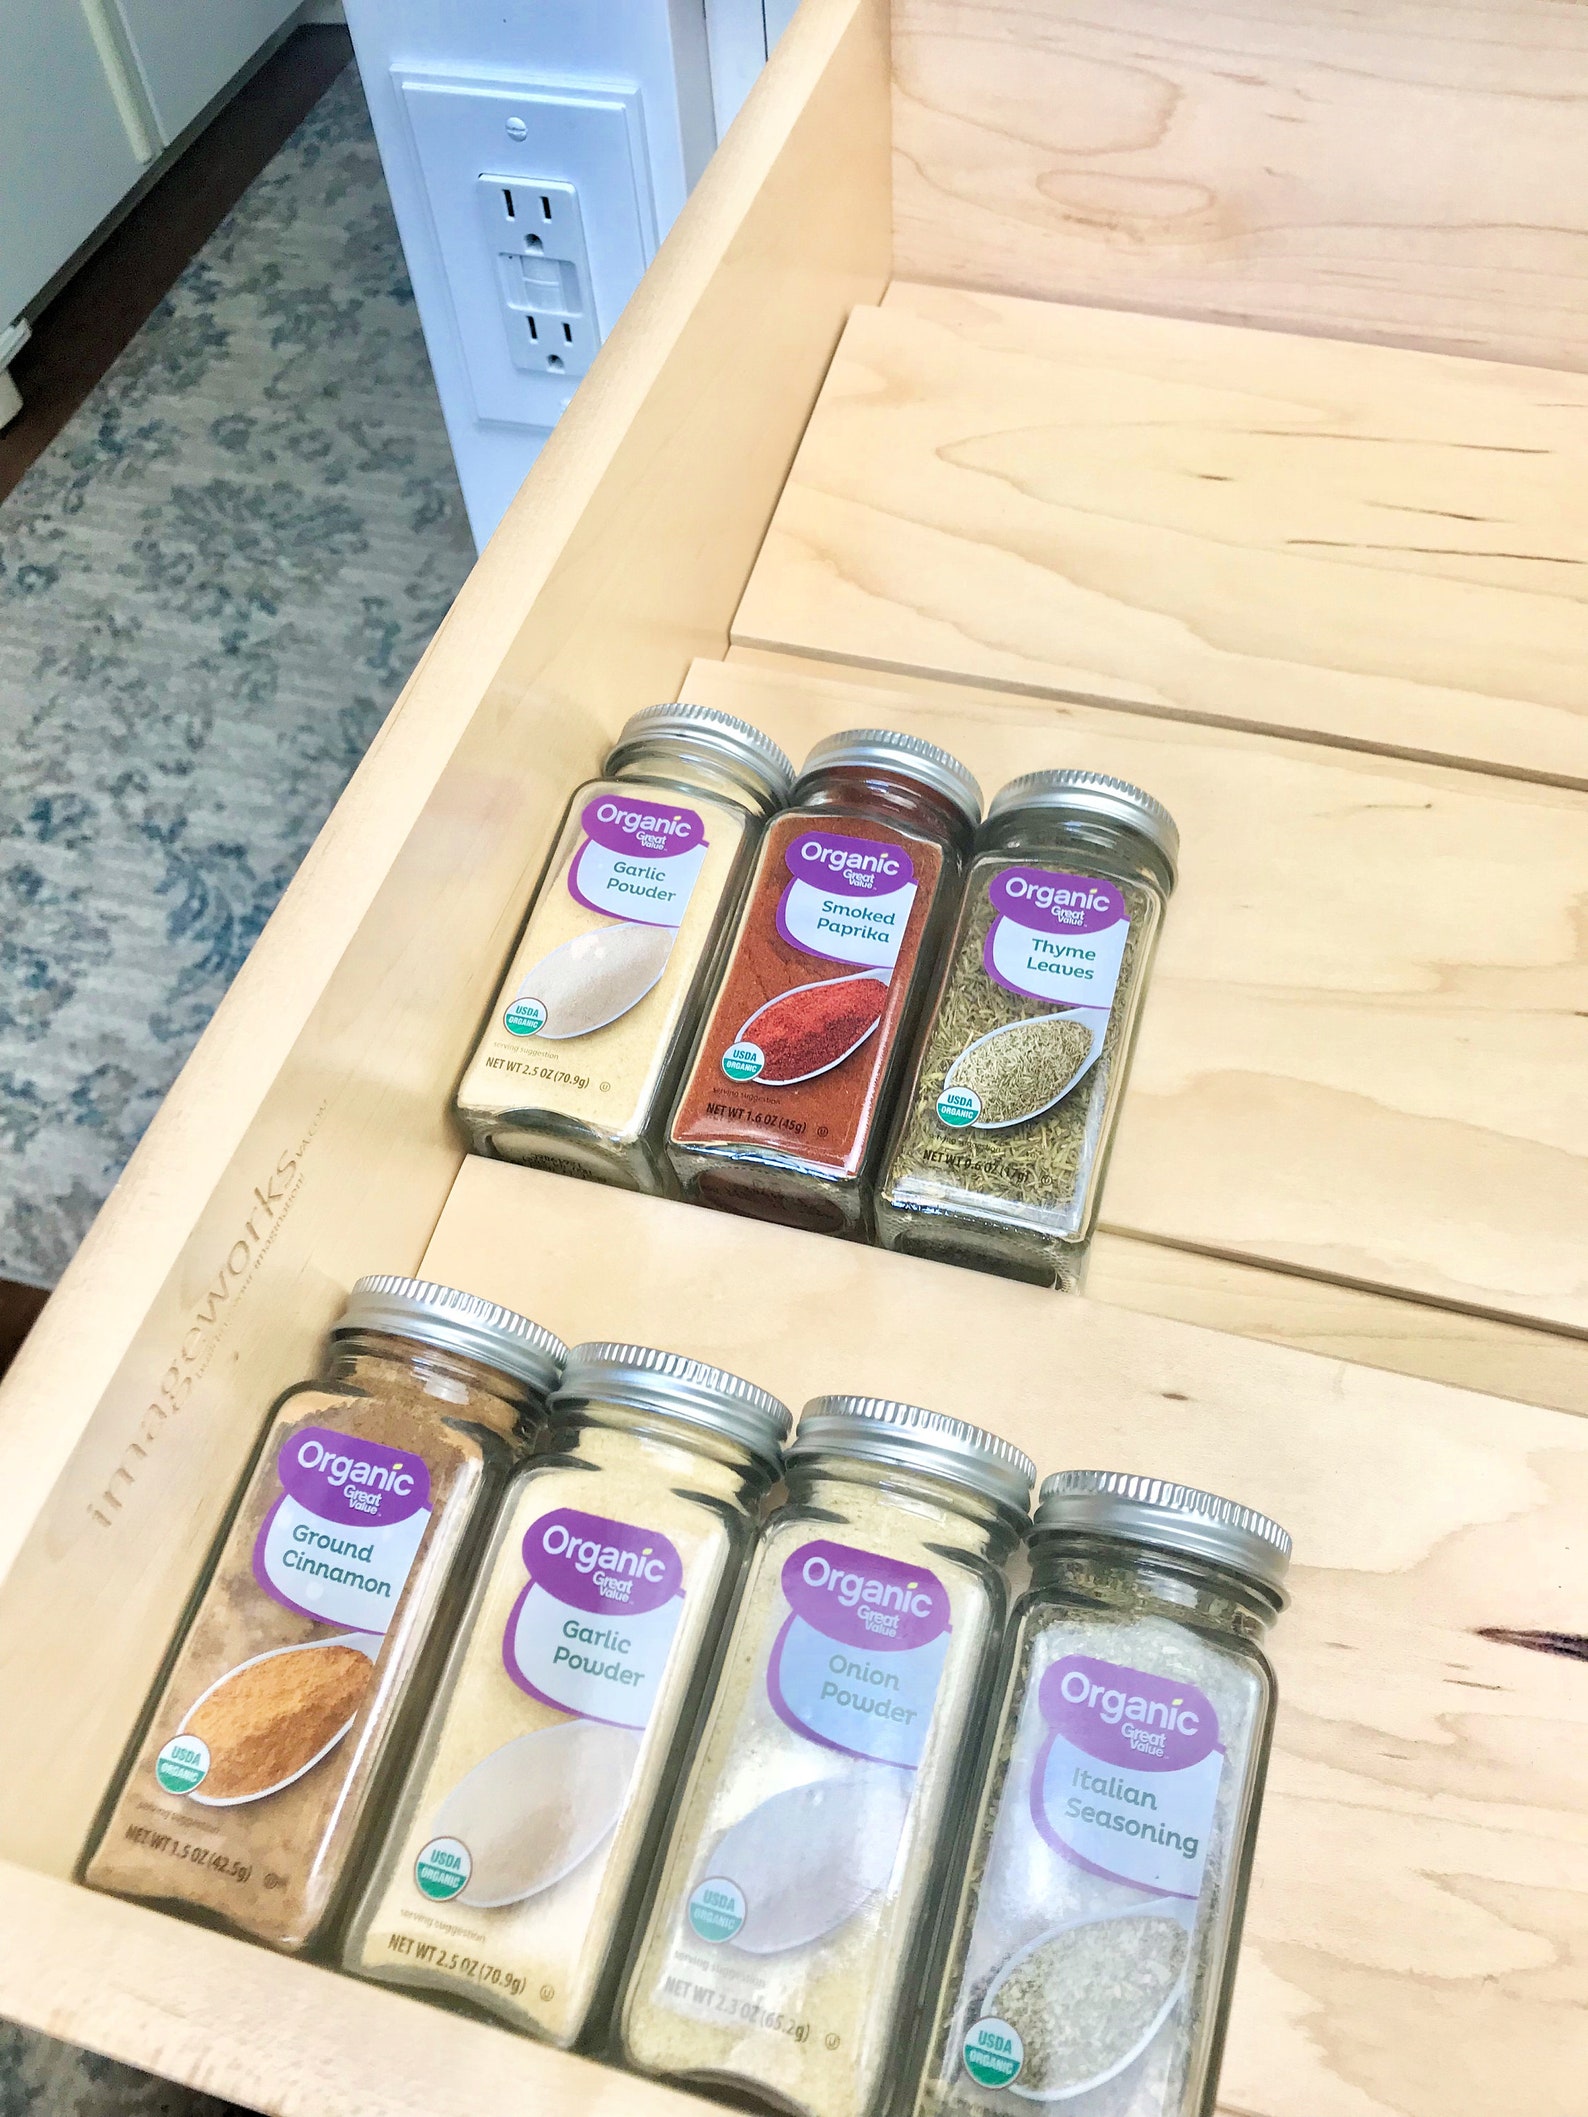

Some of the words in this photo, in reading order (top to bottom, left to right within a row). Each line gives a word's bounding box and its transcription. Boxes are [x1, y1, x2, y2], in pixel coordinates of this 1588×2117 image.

[597, 804, 691, 838] Organic
[637, 831, 667, 845] Great
[641, 840, 665, 851] Value
[801, 842, 899, 876] Organic
[614, 862, 666, 882] Garlic
[843, 870, 874, 884] Great
[849, 878, 872, 890] Value
[607, 878, 676, 902] Powder
[1006, 876, 1110, 912] Organic
[822, 900, 895, 926] Smoked
[1051, 906, 1084, 920] Great
[1057, 915, 1083, 926] Value
[817, 918, 890, 943] Paprika
[1032, 938, 1096, 961] Thyme
[1027, 957, 1094, 980] Leaves
[508, 1016, 538, 1028] ORGANIC
[516, 1006, 538, 1018] USDA
[726, 1061, 756, 1073] ORGANIC
[733, 1050, 756, 1062] USDA
[486, 1057, 505, 1069] NET
[506, 1060, 522, 1072] WT
[522, 1065, 538, 1076] 2.5
[540, 1068, 554, 1079] OZ
[554, 1070, 590, 1089] (70.9g)
[941, 1106, 974, 1119] ORGANIC
[948, 1094, 972, 1108] USDA
[706, 1103, 726, 1116] NET
[728, 1107, 744, 1118] WT
[746, 1112, 762, 1122] 1.6
[764, 1114, 778, 1126] OZ
[778, 1116, 806, 1134] (45g)
[298, 1440, 414, 1496] Organic
[344, 1484, 382, 1506] Great
[349, 1499, 379, 1516] Value
[292, 1524, 373, 1562] Ground
[542, 1524, 666, 1584] Organic
[282, 1550, 392, 1598] Cinnamon
[594, 1570, 632, 1594] Great
[600, 1586, 629, 1604] Value
[802, 1555, 932, 1618] Organic
[858, 1604, 900, 1629] Great
[562, 1620, 632, 1654] Garlic
[864, 1620, 896, 1638] Value
[552, 1646, 644, 1687] Powder
[828, 1654, 900, 1692] Onion
[820, 1681, 917, 1726] Powder
[1060, 1670, 1200, 1736] Organic
[1121, 1722, 1166, 1748] Great
[171, 1745, 202, 1766] USDA
[1130, 1739, 1164, 1758] Value
[161, 1763, 200, 1784] ORGANIC
[1072, 1768, 1158, 1811] Italian
[1065, 1798, 1199, 1860] Seasoning
[126, 1824, 152, 1844] NET
[150, 1831, 171, 1851] WT
[170, 1841, 191, 1858] 1.5
[191, 1848, 209, 1865] OZ
[207, 1852, 252, 1883] (42.5g)
[430, 1848, 462, 1870] USDA
[420, 1868, 460, 1889] ORGANIC
[704, 1889, 736, 1912] USDA
[694, 1910, 736, 1932] ORGANIC
[388, 1934, 414, 1955] NET
[416, 1942, 437, 1962] WT
[436, 1951, 458, 1970] 2.5
[460, 1958, 479, 1976] OZ
[478, 1964, 526, 1995] (70.9g)
[665, 1976, 692, 1997] NET
[693, 1984, 715, 2004] WT
[716, 1994, 738, 2014] 2.3
[740, 2002, 761, 2023] OZ
[760, 2010, 810, 2042] (65.2g)
[978, 2030, 1012, 2054] USDA
